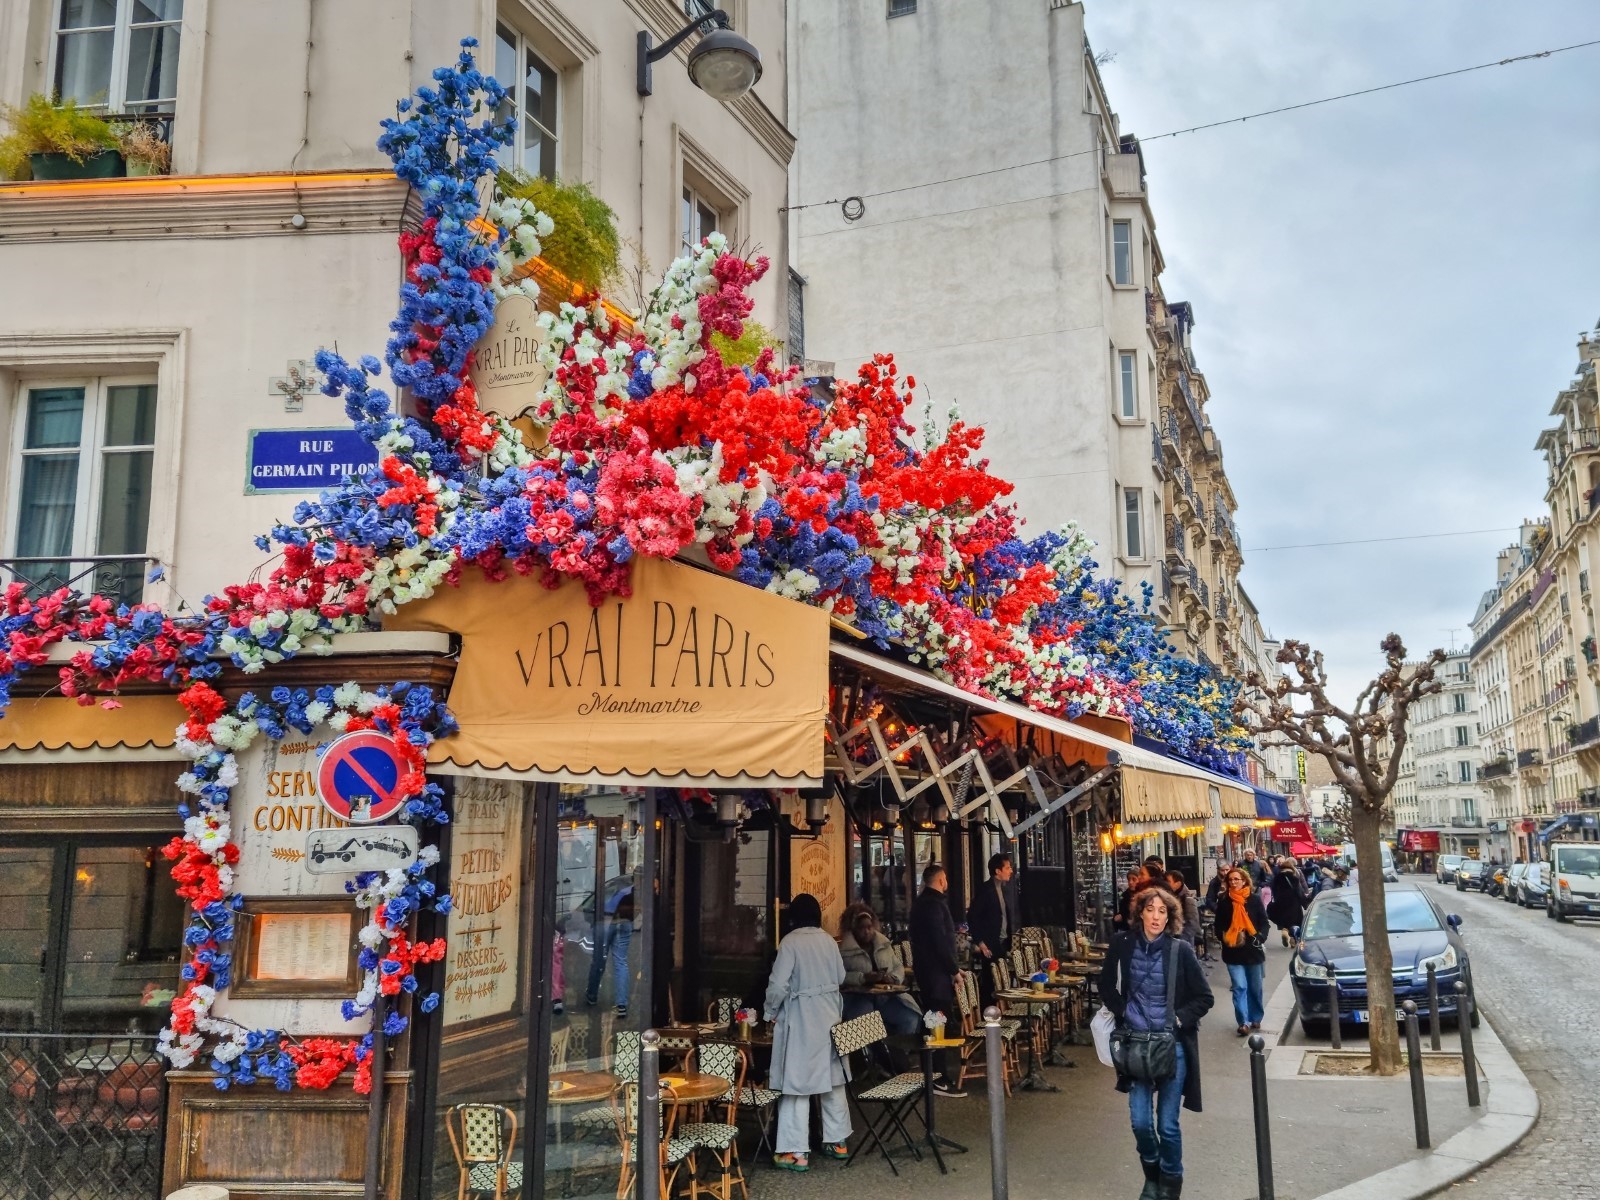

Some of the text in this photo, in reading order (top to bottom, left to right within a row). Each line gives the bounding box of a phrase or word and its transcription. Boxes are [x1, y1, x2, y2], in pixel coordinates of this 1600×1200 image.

[505, 319, 520, 333] Le
[474, 336, 542, 371] VRAI PAR
[299, 440, 334, 453] RUE
[252, 463, 324, 477] GERMAIN
[515, 600, 775, 688] VRAI PARIS
[577, 692, 702, 716] Montmartre
[1297, 751, 1306, 778] HOTEL
[267, 771, 317, 797] SERV
[467, 802, 500, 819] FRAIS
[460, 847, 501, 875] PETITS
[456, 947, 498, 969] DESSERTS
